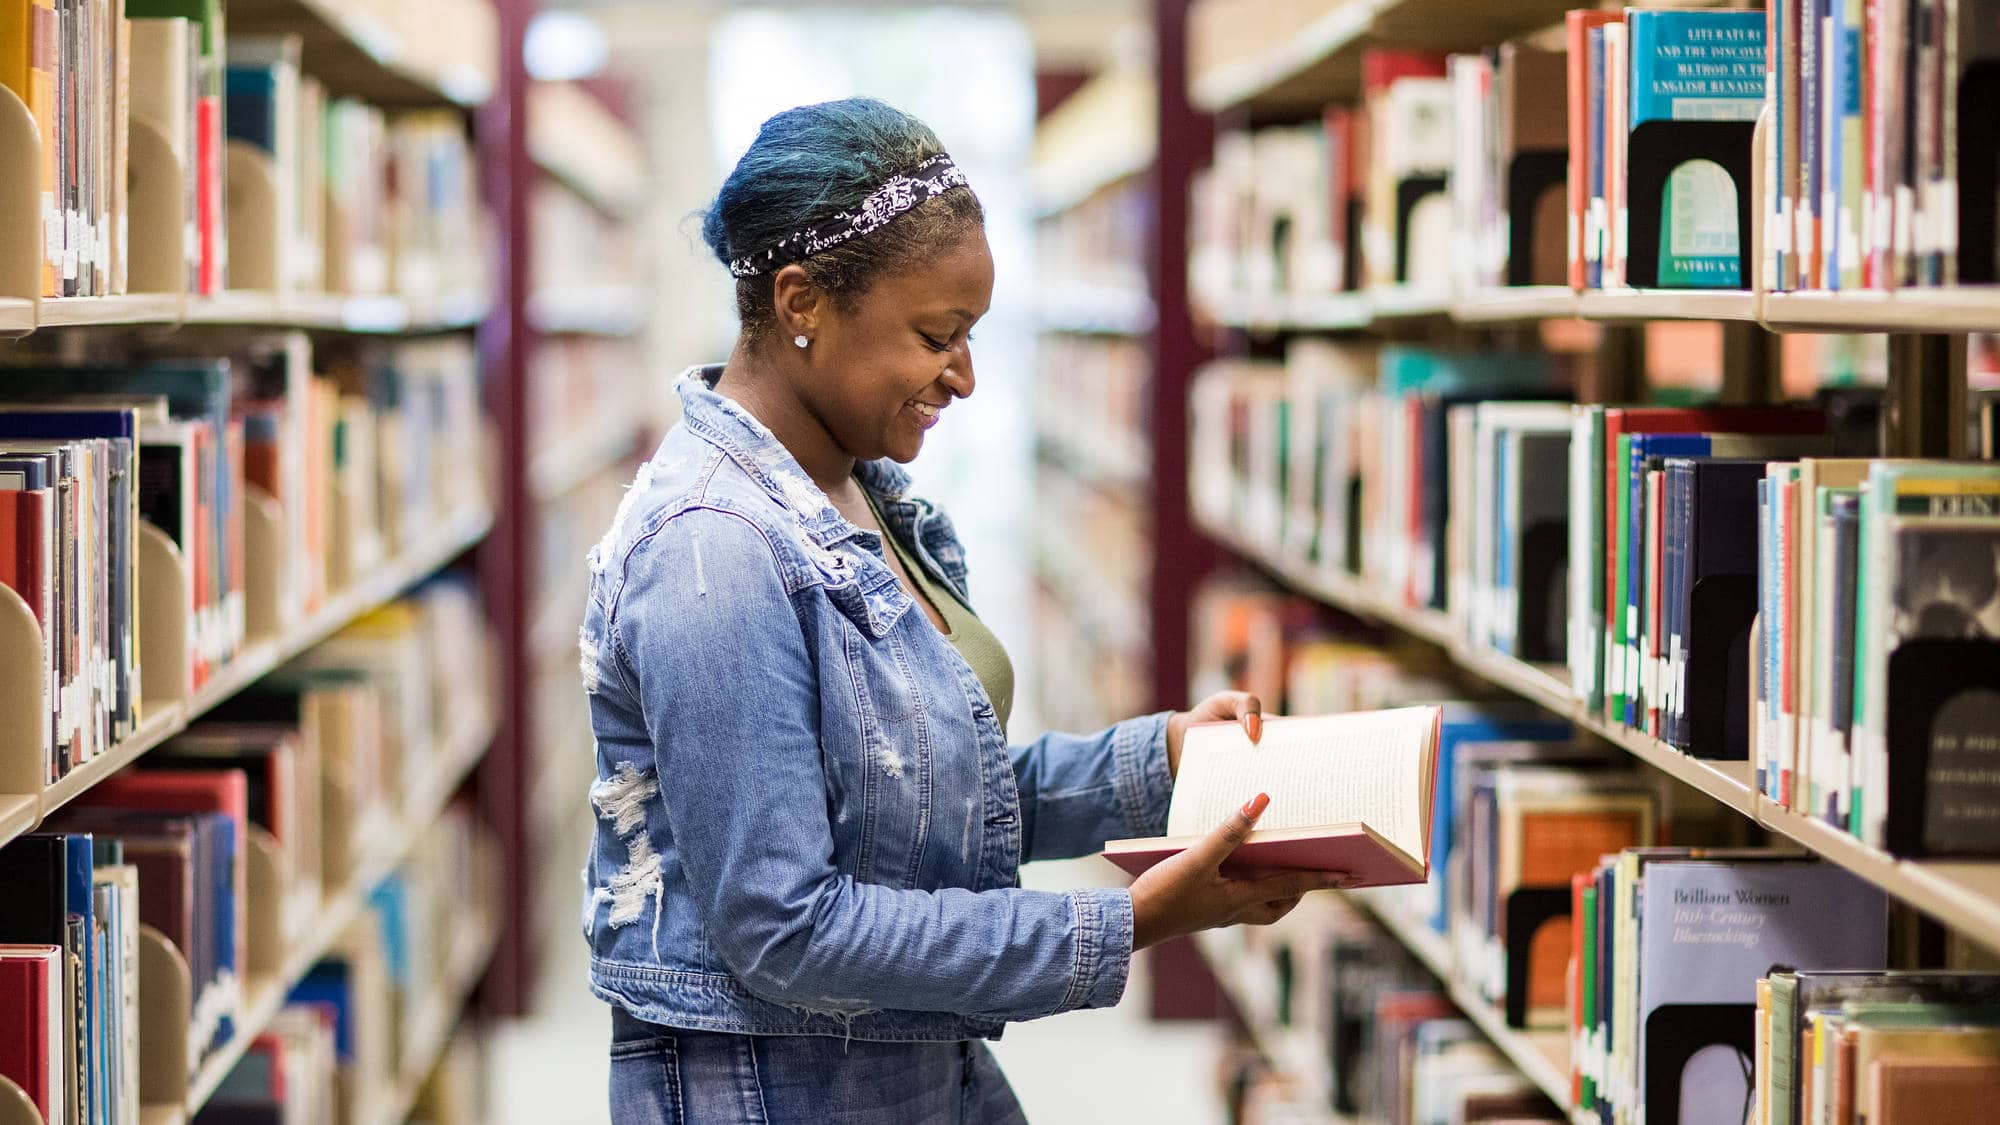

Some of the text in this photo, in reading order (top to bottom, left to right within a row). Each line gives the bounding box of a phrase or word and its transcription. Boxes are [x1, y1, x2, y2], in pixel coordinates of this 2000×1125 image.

[1656, 46, 1681, 58] AND
[1684, 46, 1706, 58] THE
[1677, 63, 1729, 76] METHOD
[1732, 63, 1747, 76] IN
[1652, 80, 1706, 93] ENGLISH
[1673, 260, 1726, 273] PATRICK
[1674, 887, 1791, 905] Brilliant Women
